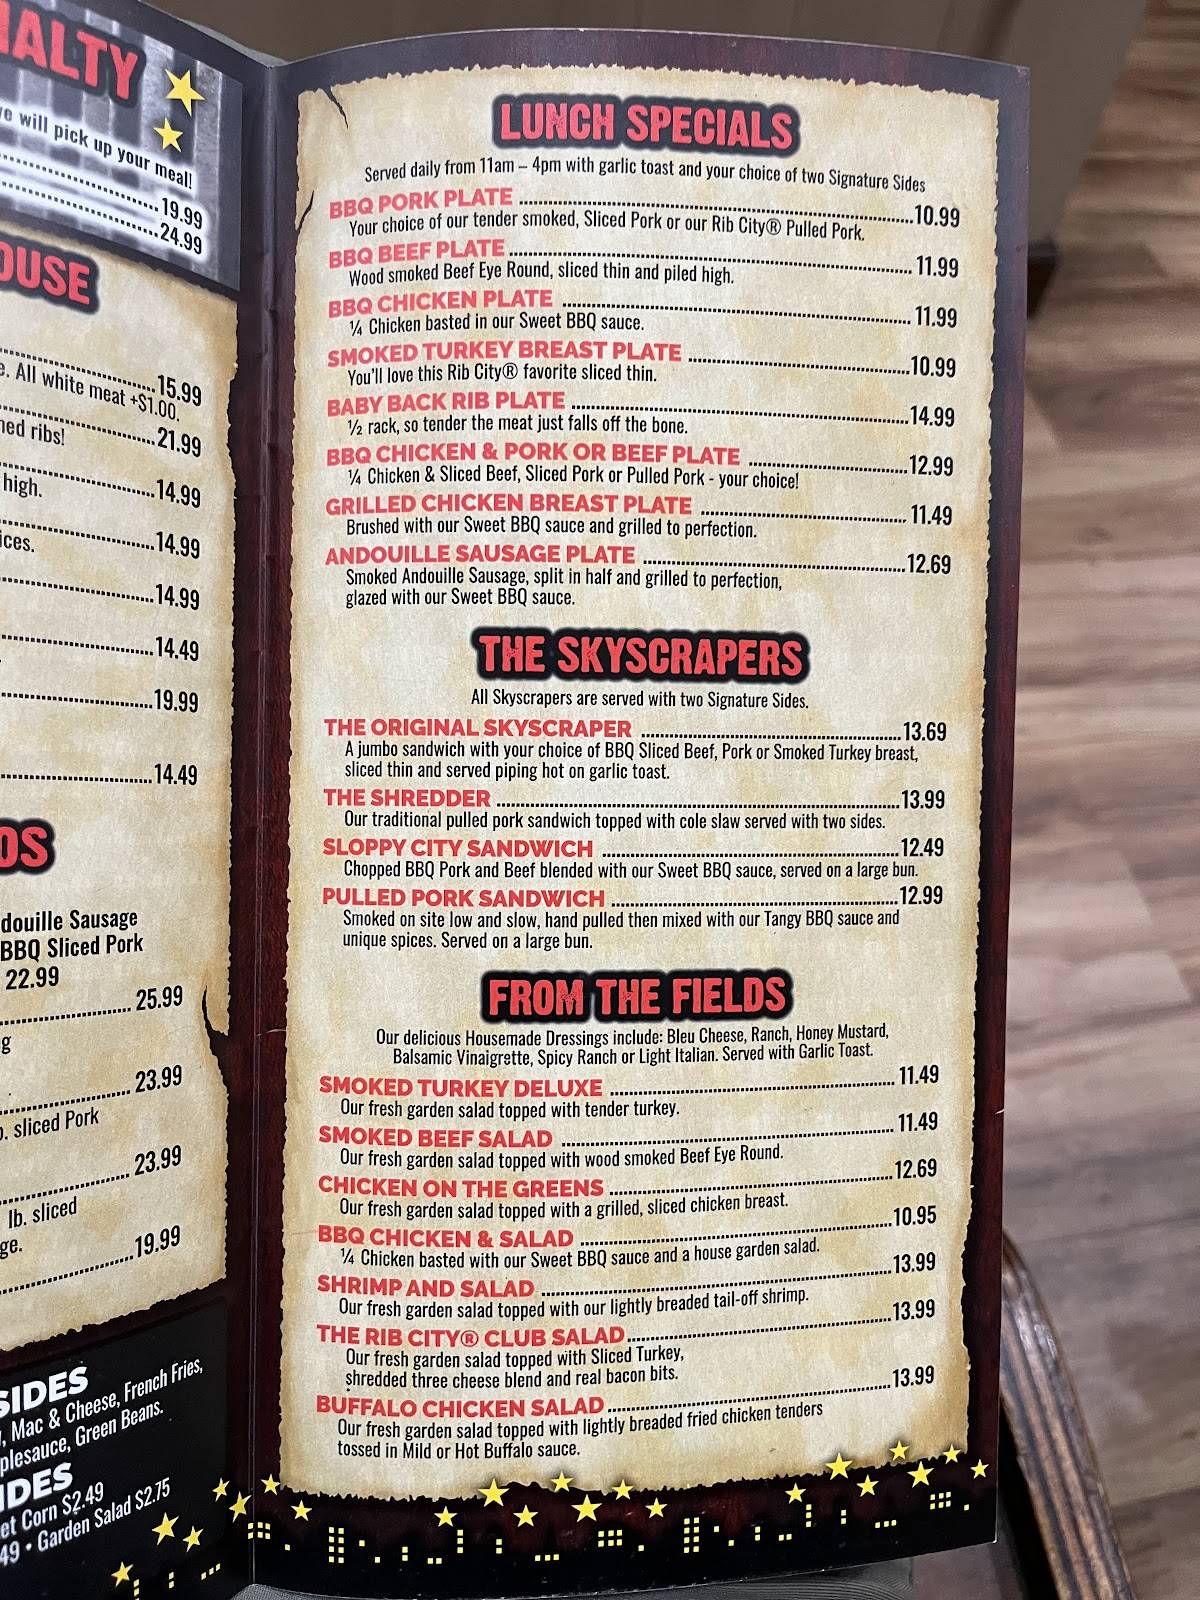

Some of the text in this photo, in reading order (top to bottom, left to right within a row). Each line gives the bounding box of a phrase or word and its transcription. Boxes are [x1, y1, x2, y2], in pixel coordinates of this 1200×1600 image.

[501, 103, 793, 150] LUNCH SPECIALS
[19, 114, 48, 134] will
[54, 123, 89, 148] pick
[94, 138, 112, 158] up
[117, 147, 150, 171] your
[155, 162, 192, 190] meal!
[365, 162, 406, 182] Served
[410, 160, 441, 178] daily
[445, 159, 475, 175] from
[480, 157, 514, 173] 11am
[532, 156, 561, 175] 4pm
[566, 156, 594, 173] with
[599, 157, 636, 176] garlic
[641, 159, 674, 176] toast
[679, 161, 702, 177] and
[706, 165, 735, 180] your
[739, 163, 780, 181] choice
[785, 167, 797, 183] of
[802, 168, 824, 184] two
[829, 169, 889, 189] Signature
[893, 174, 925, 193] Sides
[162, 197, 203, 230] 19.99
[329, 187, 960, 228] BBQ PORK PLATE 10.99
[160, 222, 202, 255] 24.99
[329, 239, 958, 278] BBQ BEEF PLATE 11.99
[349, 260, 734, 287] Wood smoked Beef Eye Round, sliced thin and piled high.
[16, 362, 37, 384] All
[42, 371, 84, 395] white
[89, 384, 126, 407] meat
[157, 374, 202, 407] 15.99
[31, 424, 65, 446] ribs!
[157, 426, 201, 458] 21.99
[3, 473, 42, 498] high.
[156, 479, 201, 508] 14.99
[156, 531, 200, 559] 14.99
[325, 544, 951, 575] ANDOUILLE SAUSAGE PLATE 12.69
[155, 584, 200, 611] 14.99
[155, 636, 199, 662] 14.49
[479, 635, 802, 676] THE SKYSCRAPERS
[154, 688, 199, 713] 19.99
[471, 688, 809, 710] All Skyscrapers are served with two Signature Sides.
[154, 763, 198, 786] 14.49
[323, 788, 945, 809] THE SHREDDER 13.99
[322, 885, 943, 909] PULLED PORK SANDWICH 12.99
[1, 909, 138, 934] douille Sausage
[0, 933, 144, 963] BBQ Sliced Pork
[343, 931, 592, 952] unique spices. Served on a large bun.
[5, 966, 60, 991] 22.99
[136, 985, 183, 1011] 25.99
[489, 977, 785, 1015] FROM THE FIELDS
[135, 1065, 182, 1093] 23.99
[319, 1064, 939, 1098] SMOKED TURKEY DELUXE 11.49
[14, 1112, 60, 1138] sliced
[65, 1106, 99, 1130] Pork
[134, 1145, 182, 1176] 23.99
[318, 1158, 937, 1199] CHICKEN ON THE GREENS 12.69
[32, 1196, 77, 1224] sliced
[134, 1225, 181, 1258] 19.99
[317, 1252, 936, 1298] SHRIMP AND SALAD 13.99
[339, 1287, 809, 1322] Our fresh garden salad topped with our lightly breaded tail-off shrimp.
[12, 1417, 43, 1442] Mac
[49, 1408, 61, 1429] &
[65, 1391, 121, 1423] Cheese,
[124, 1369, 168, 1403] French
[171, 1358, 203, 1384] Fries,
[315, 1365, 934, 1419] BUFFALO CHICKEN SALAD 13.99
[75, 1418, 117, 1447] Green
[121, 1401, 164, 1429] Beans.
[21, 1504, 58, 1531] Corn
[61, 1481, 104, 1516] $2.49
[38, 1477, 170, 1552] Garden Salad $2.75
